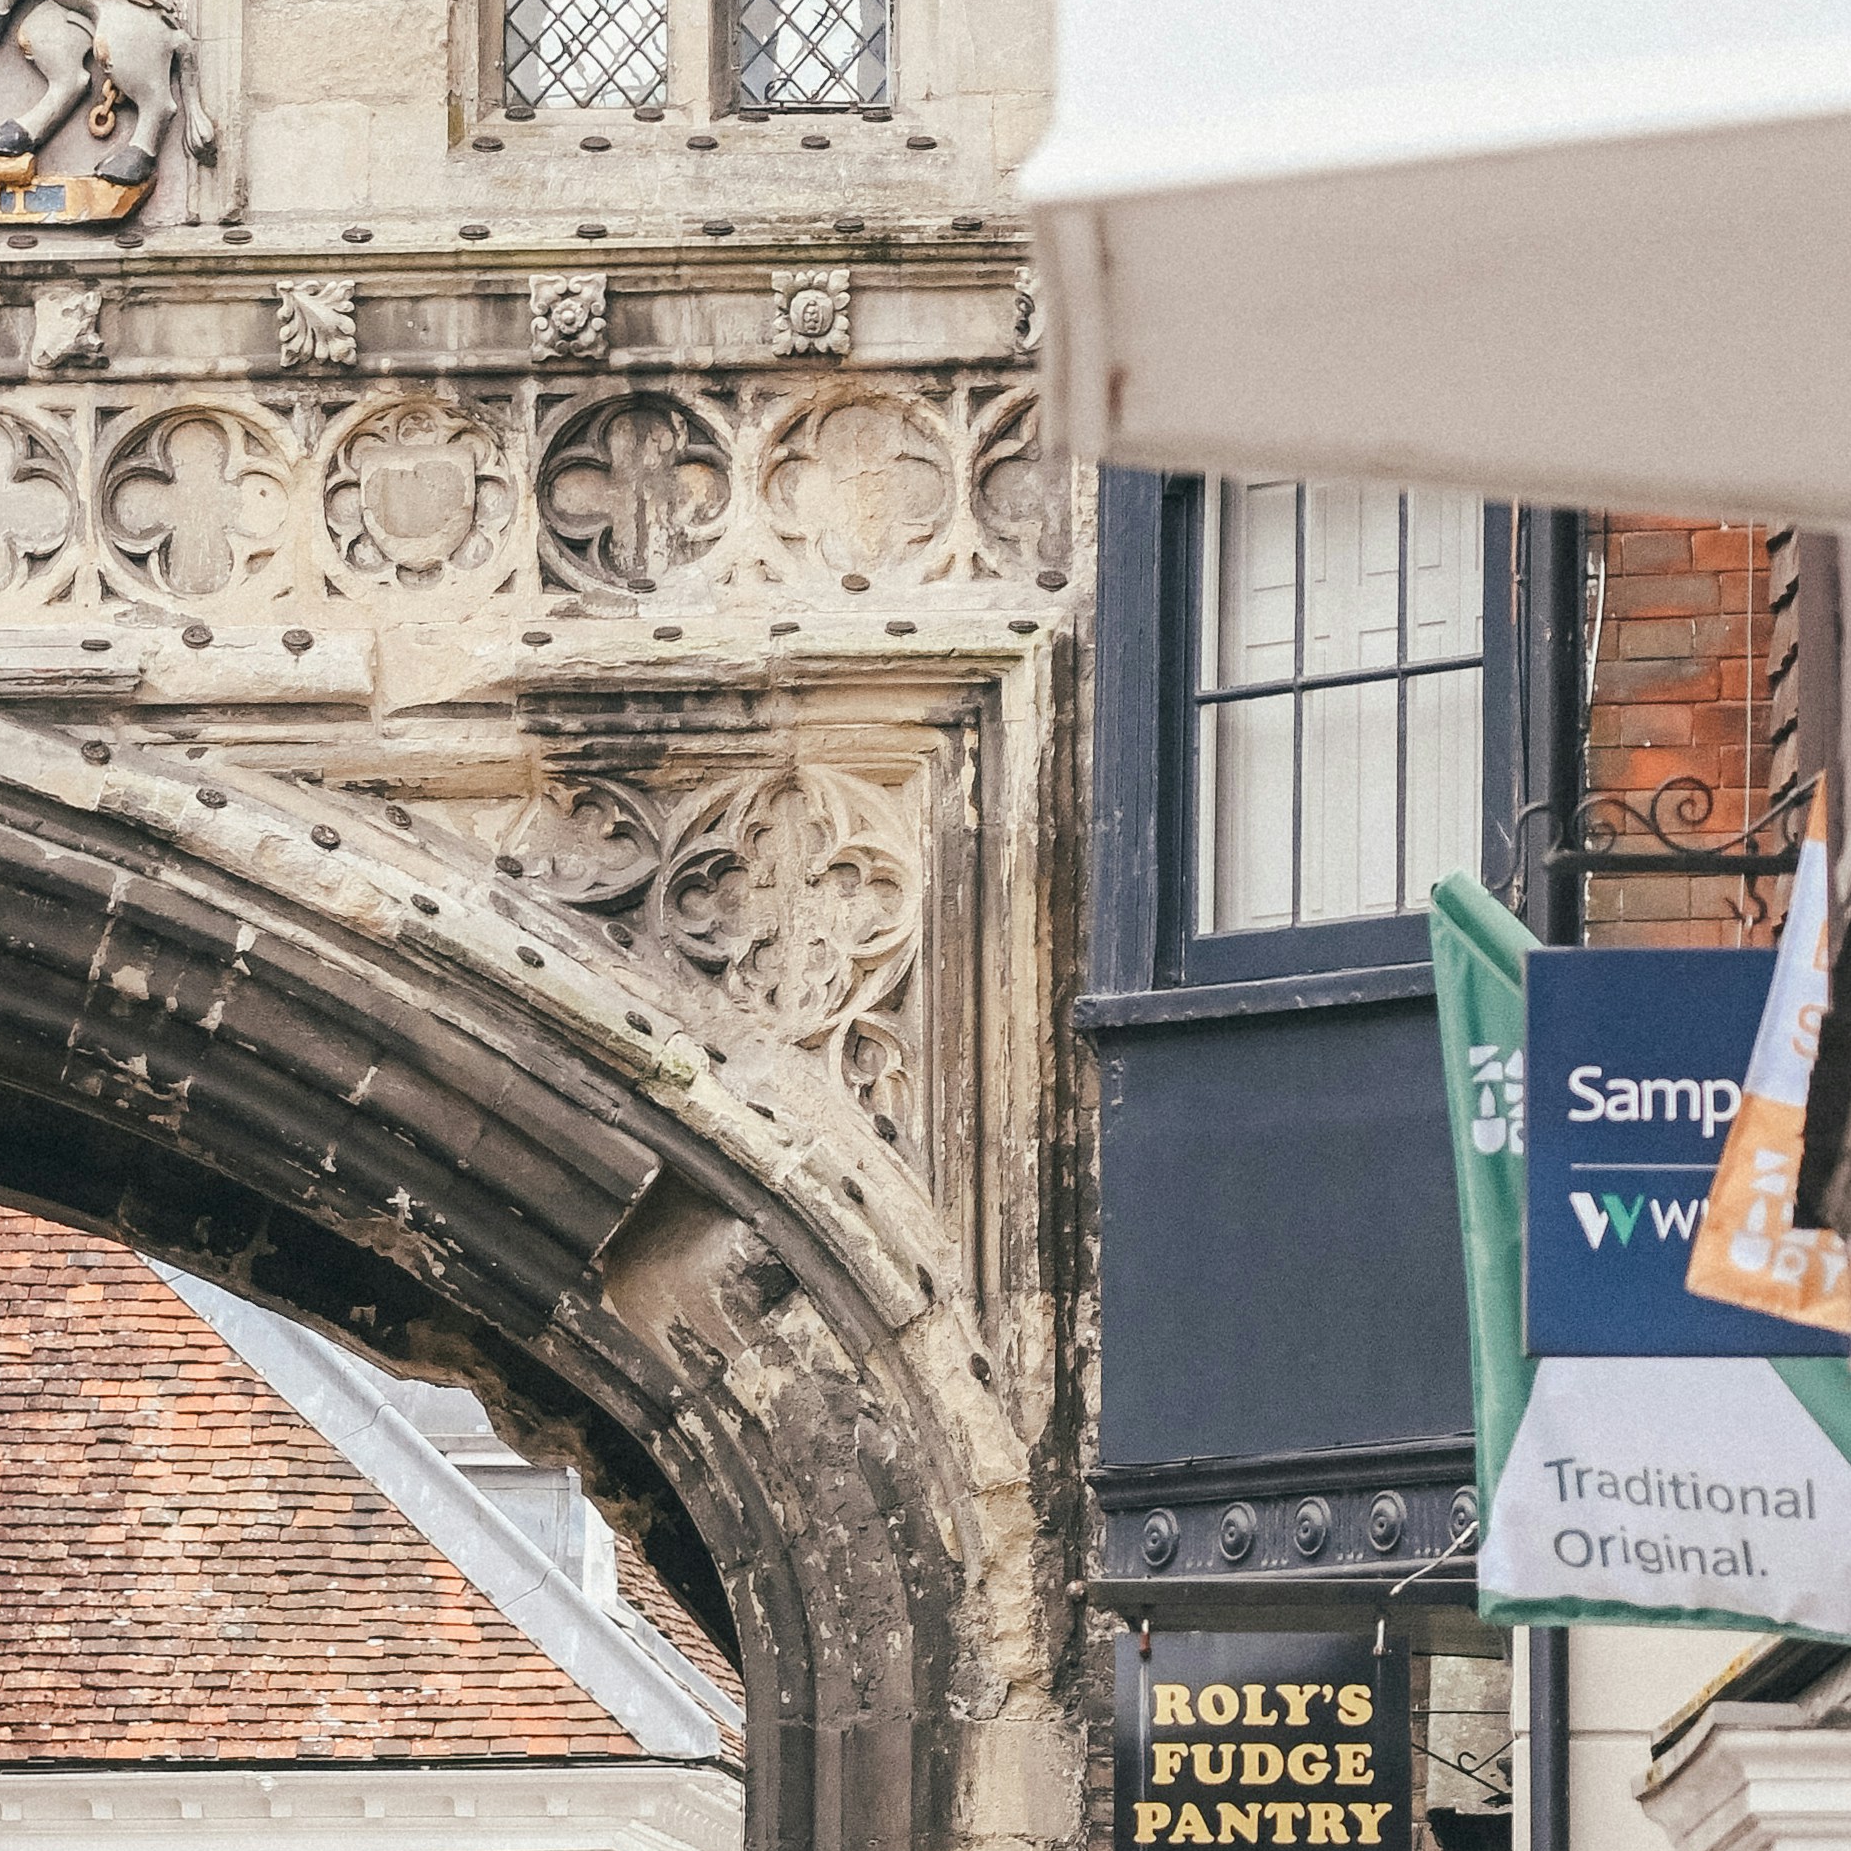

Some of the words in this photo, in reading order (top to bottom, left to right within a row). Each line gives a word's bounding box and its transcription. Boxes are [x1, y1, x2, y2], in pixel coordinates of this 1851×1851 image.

[1543, 1457, 1816, 1520] Traditional
[1553, 1524, 1769, 1578] Original.
[1152, 1683, 1374, 1727] ROLY'S
[1151, 1742, 1375, 1785] FUDGE
[1133, 1802, 1393, 1845] PANTRY
